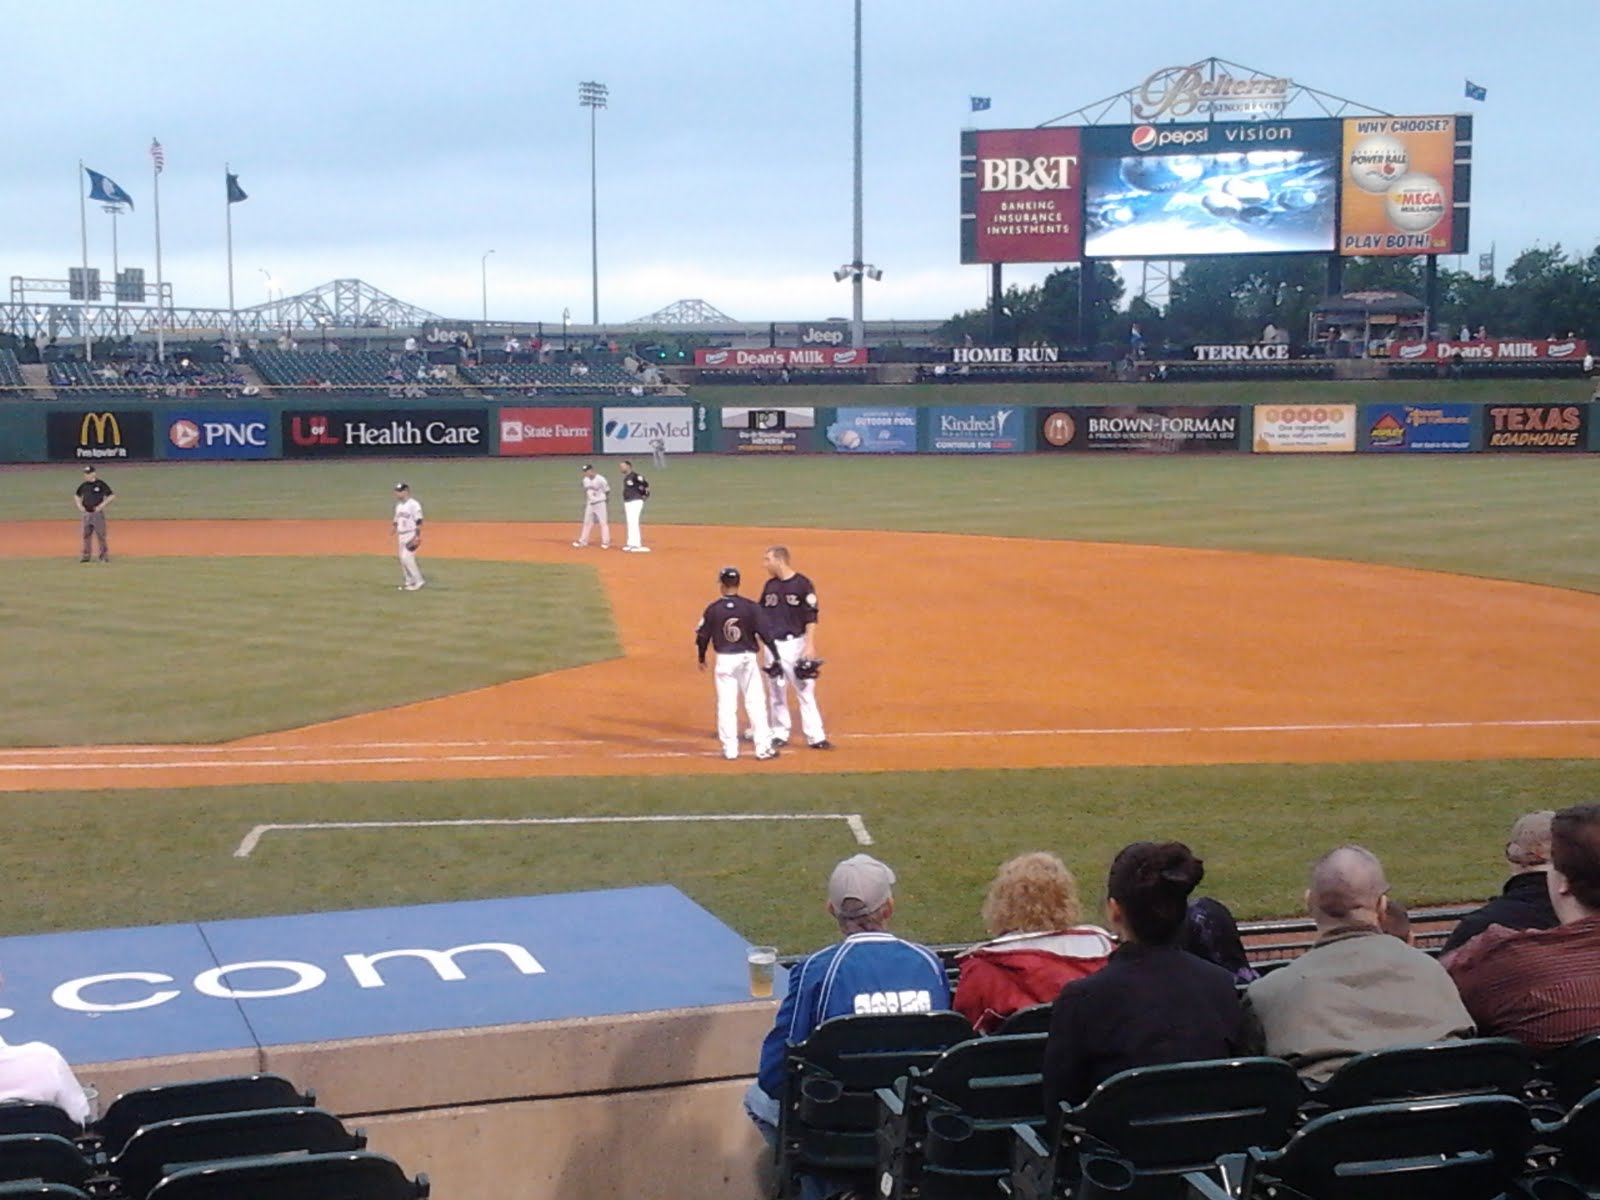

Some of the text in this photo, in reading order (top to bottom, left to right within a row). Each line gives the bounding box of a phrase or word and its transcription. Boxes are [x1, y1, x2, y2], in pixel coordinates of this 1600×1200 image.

[1134, 65, 1290, 119] Belterra
[1358, 119, 1450, 133] WHY CHOOSE?
[1159, 125, 1292, 146] pepsi vision
[980, 155, 1077, 192] BB&T
[1001, 200, 1055, 211] BANKING
[1402, 193, 1441, 205] MEGA
[994, 212, 1062, 223] INSURANCE
[987, 224, 1070, 235] INVESTMENTS
[1345, 235, 1382, 249] PLAY
[1386, 234, 1430, 248] BOTH!
[802, 328, 843, 344] Jeep
[737, 350, 825, 364] Dean's Milk
[953, 347, 1059, 362] HOME RUN
[1193, 345, 1290, 360] TERRACE
[1498, 342, 1538, 357] Milk
[941, 414, 996, 431] Kindred
[1088, 417, 1236, 433] BROWN-FORMAN
[1490, 406, 1581, 430] TEXAS
[203, 423, 266, 446] PNC
[344, 421, 421, 444] Health
[425, 421, 480, 445] Care
[524, 424, 588, 438] State Farm
[630, 422, 691, 438] ZinMed
[1489, 432, 1579, 446] ROADHOUSE
[723, 617, 741, 642] 6
